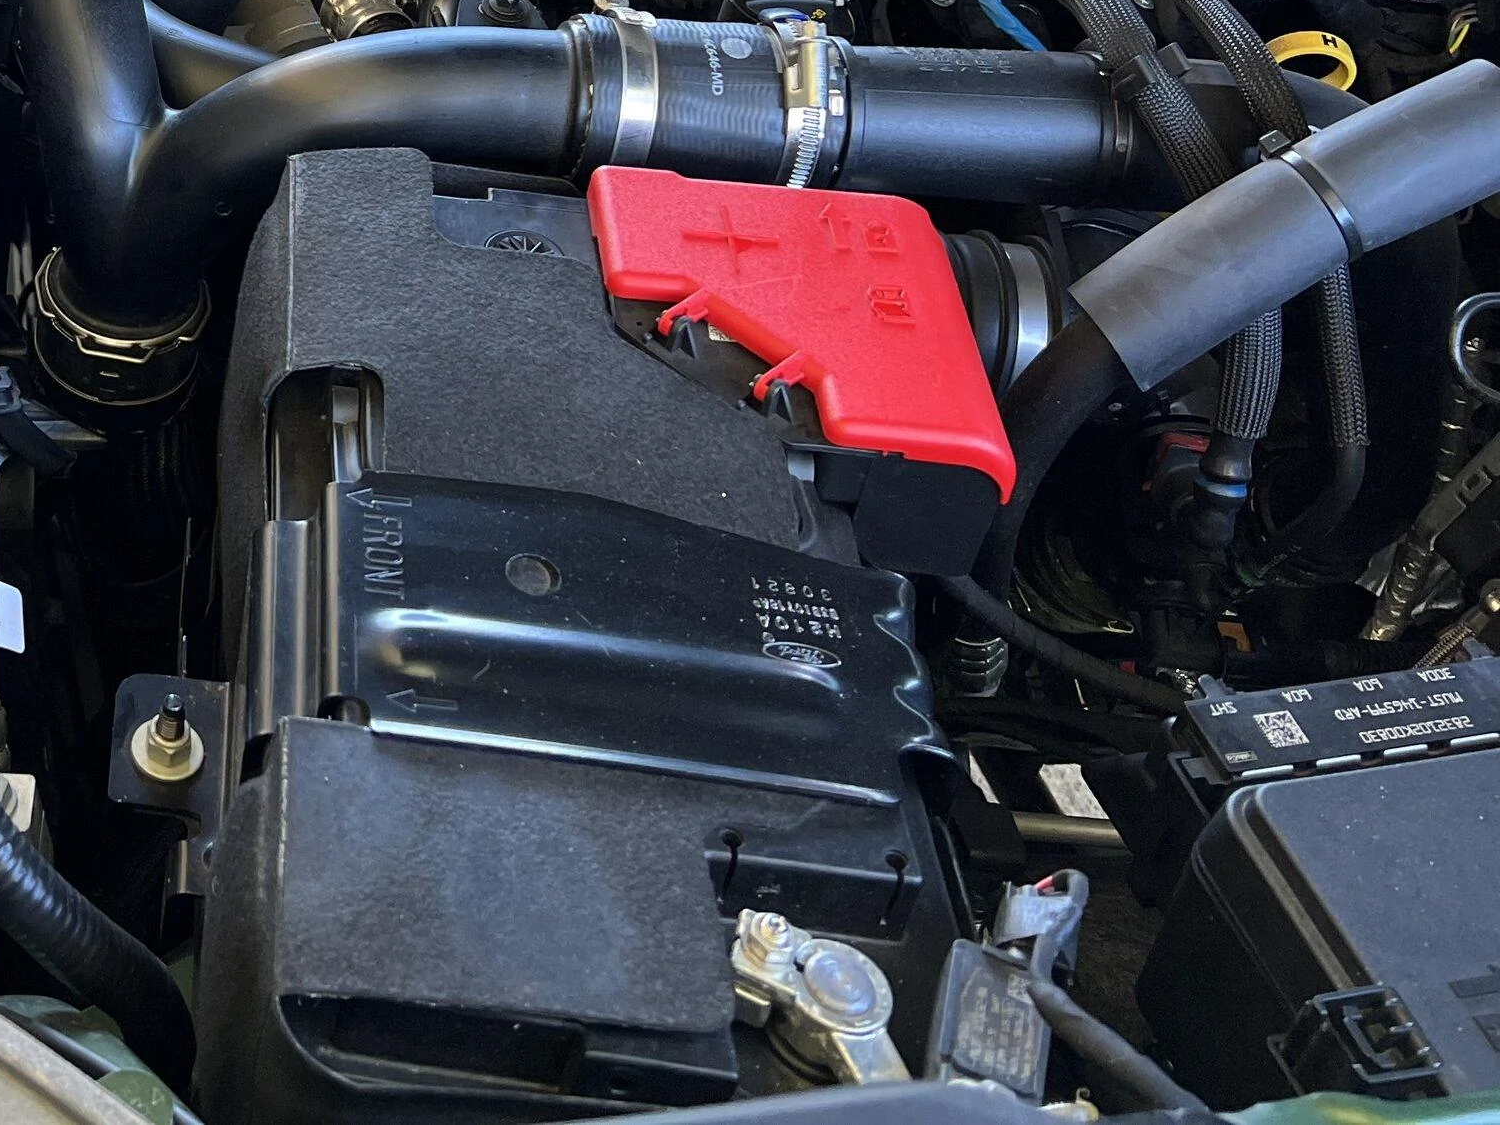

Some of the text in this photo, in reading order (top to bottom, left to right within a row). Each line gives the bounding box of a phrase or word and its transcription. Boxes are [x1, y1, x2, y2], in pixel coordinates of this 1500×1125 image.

[363, 513, 405, 600] FRONT
[1417, 667, 1456, 683] 300A
[1353, 677, 1384, 693] 60A
[1281, 687, 1312, 703] 60A
